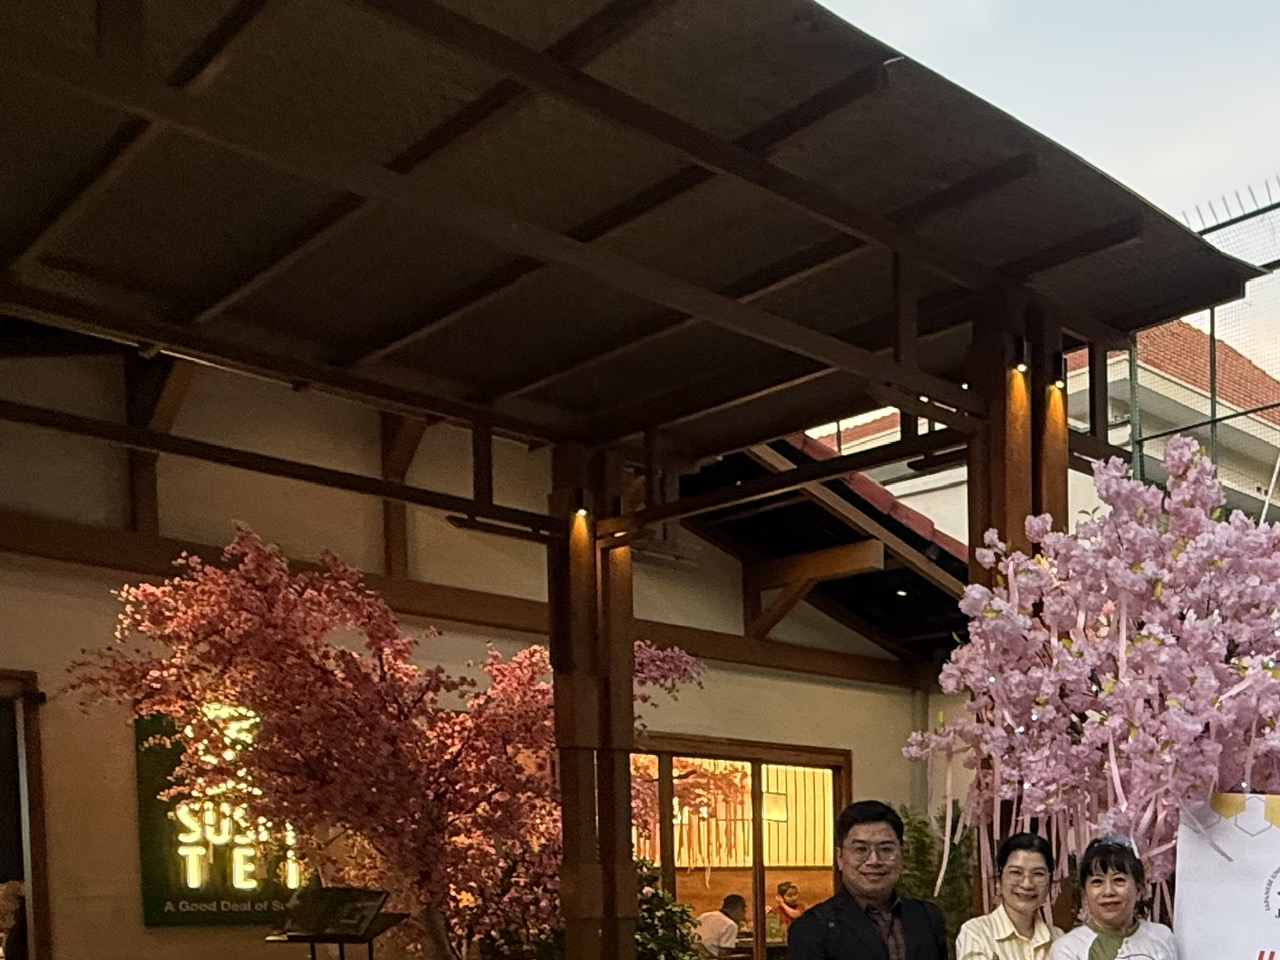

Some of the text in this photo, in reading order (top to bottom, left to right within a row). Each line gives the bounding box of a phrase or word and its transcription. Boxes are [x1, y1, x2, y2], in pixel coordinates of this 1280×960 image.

[177, 845, 299, 889] TEI
[164, 901, 175, 912] A
[178, 900, 217, 912] Good
[220, 900, 251, 912] Deal
[254, 900, 269, 911] of
[1264, 879, 1273, 911] JAPANESE
